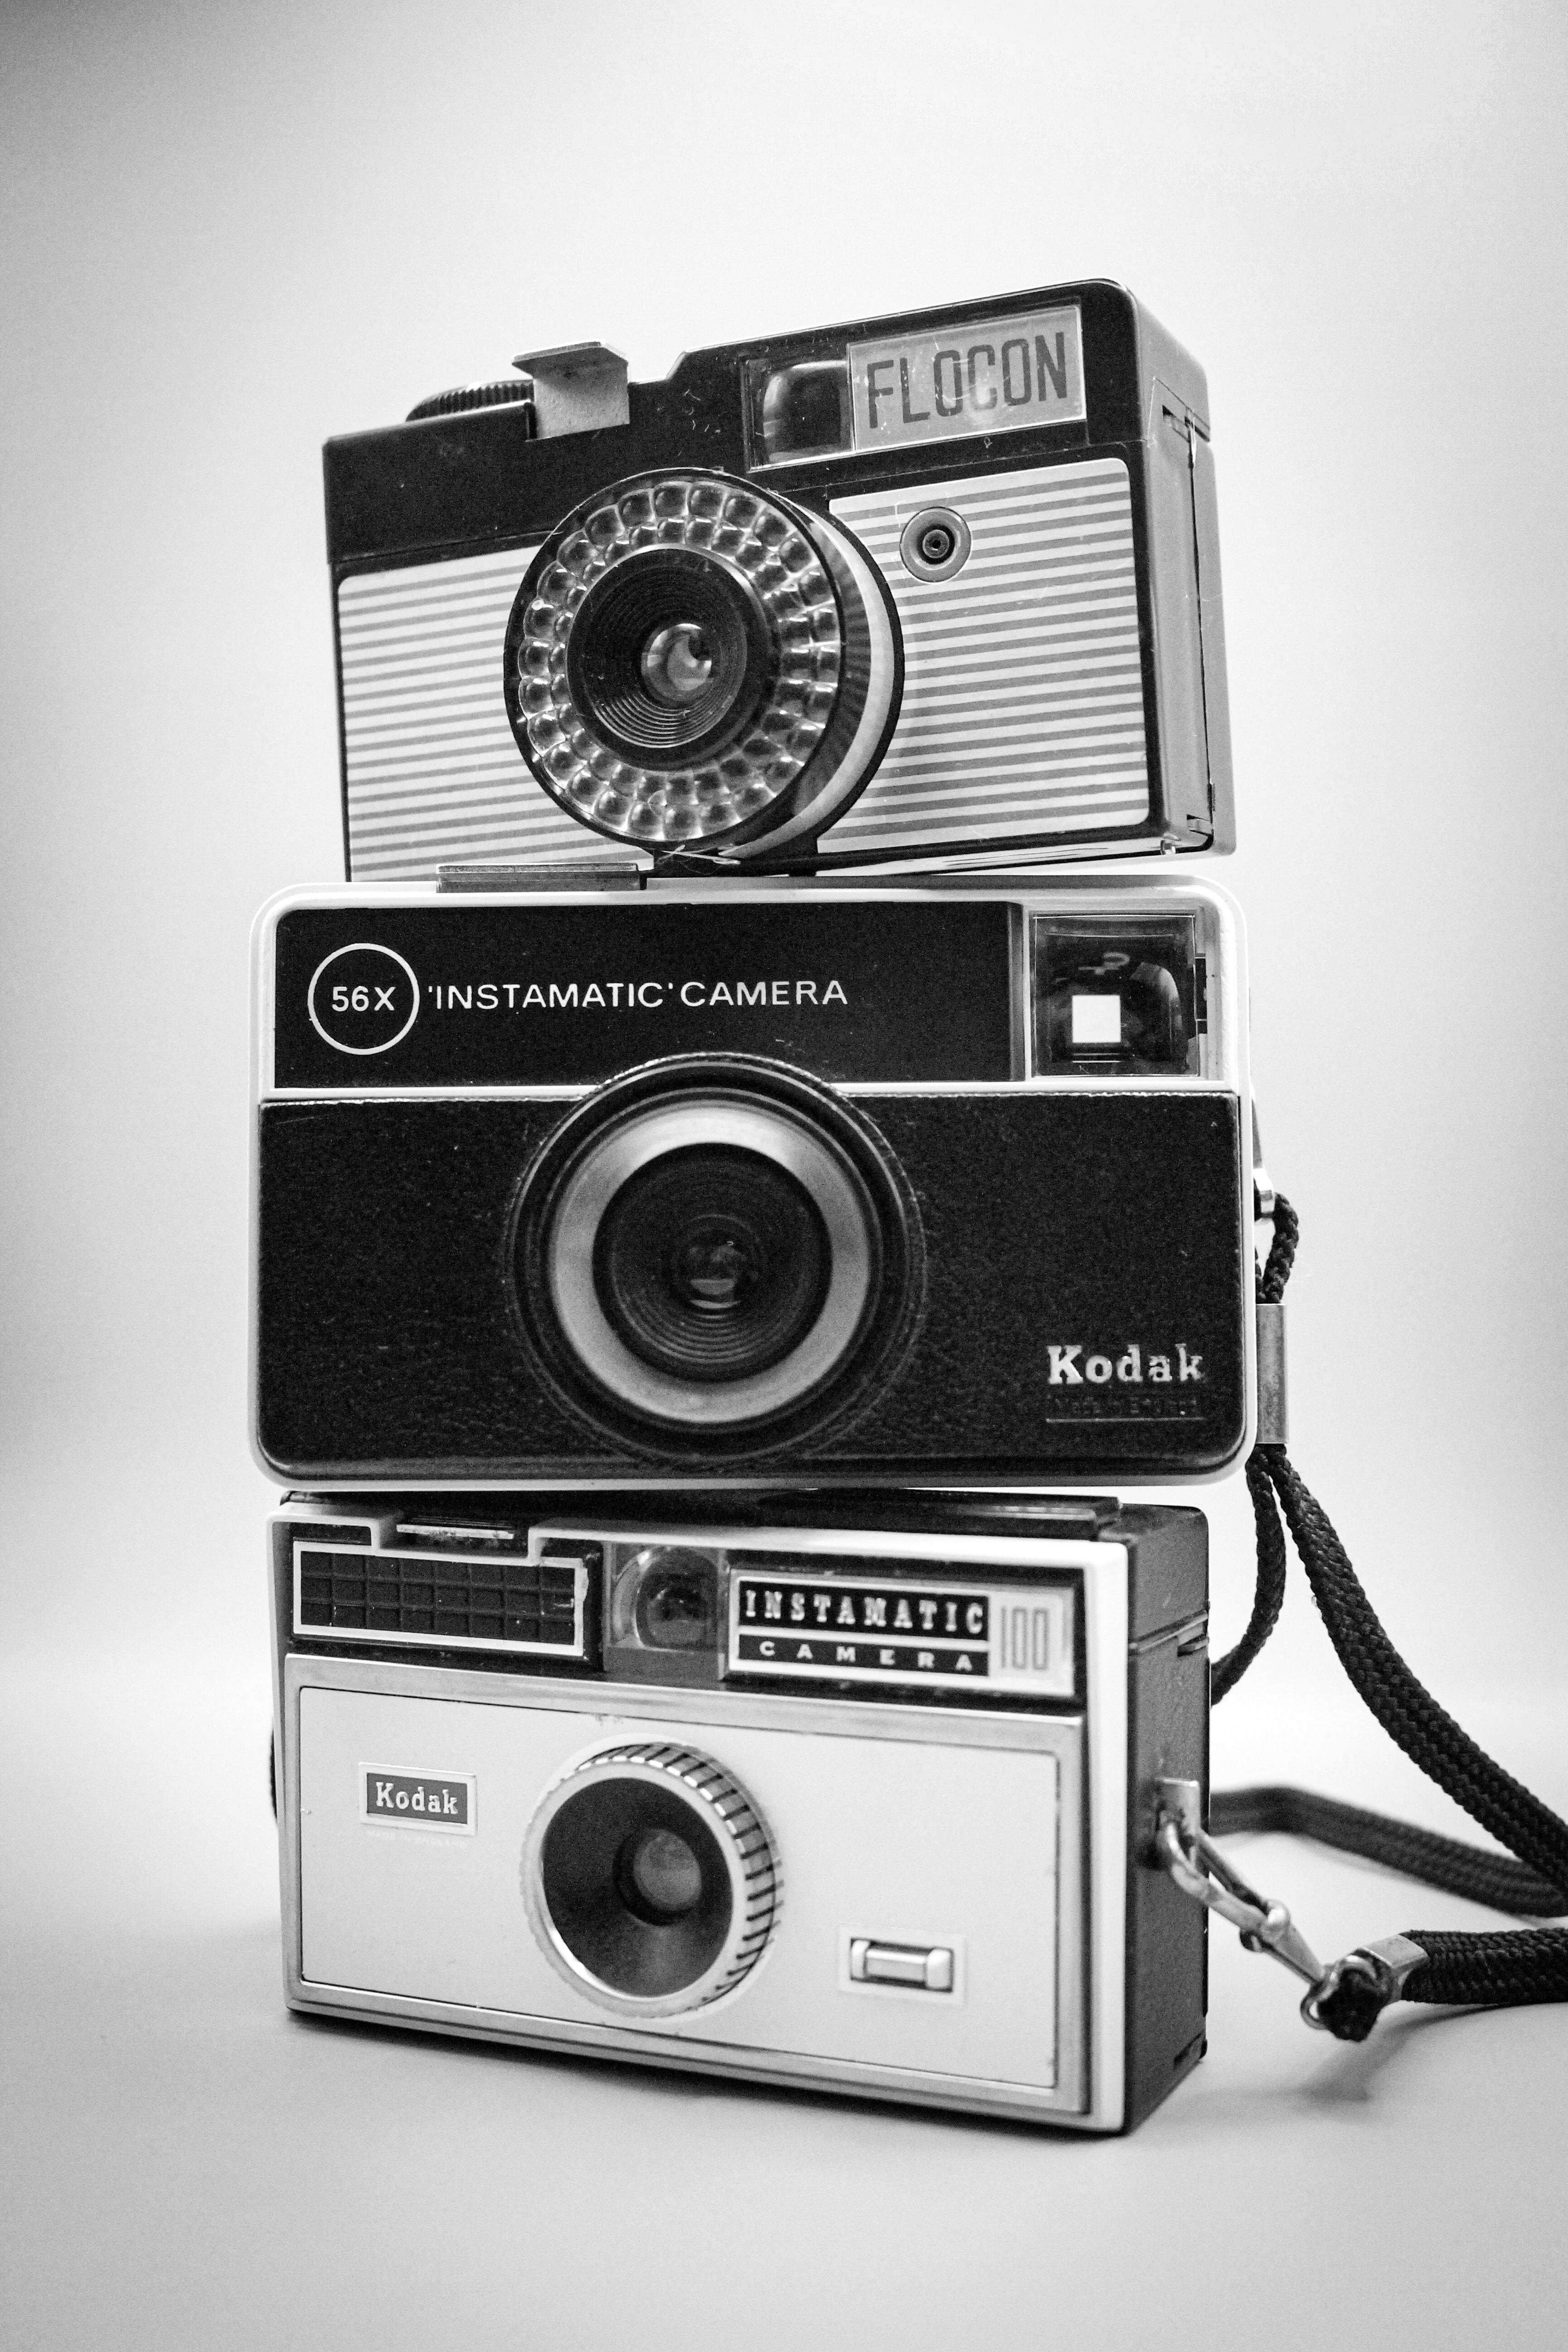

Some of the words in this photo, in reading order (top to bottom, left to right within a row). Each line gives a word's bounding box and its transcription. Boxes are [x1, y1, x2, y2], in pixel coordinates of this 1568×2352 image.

[867, 332, 1067, 429] FLOCON
[332, 986, 395, 1011] 56X
[680, 980, 848, 1007] CAMERA
[1046, 1343, 1203, 1384] Kodak
[745, 1589, 983, 1634] INSTAMATIC
[759, 1641, 972, 1671] CAMERA
[375, 1781, 458, 1814] Kodak
